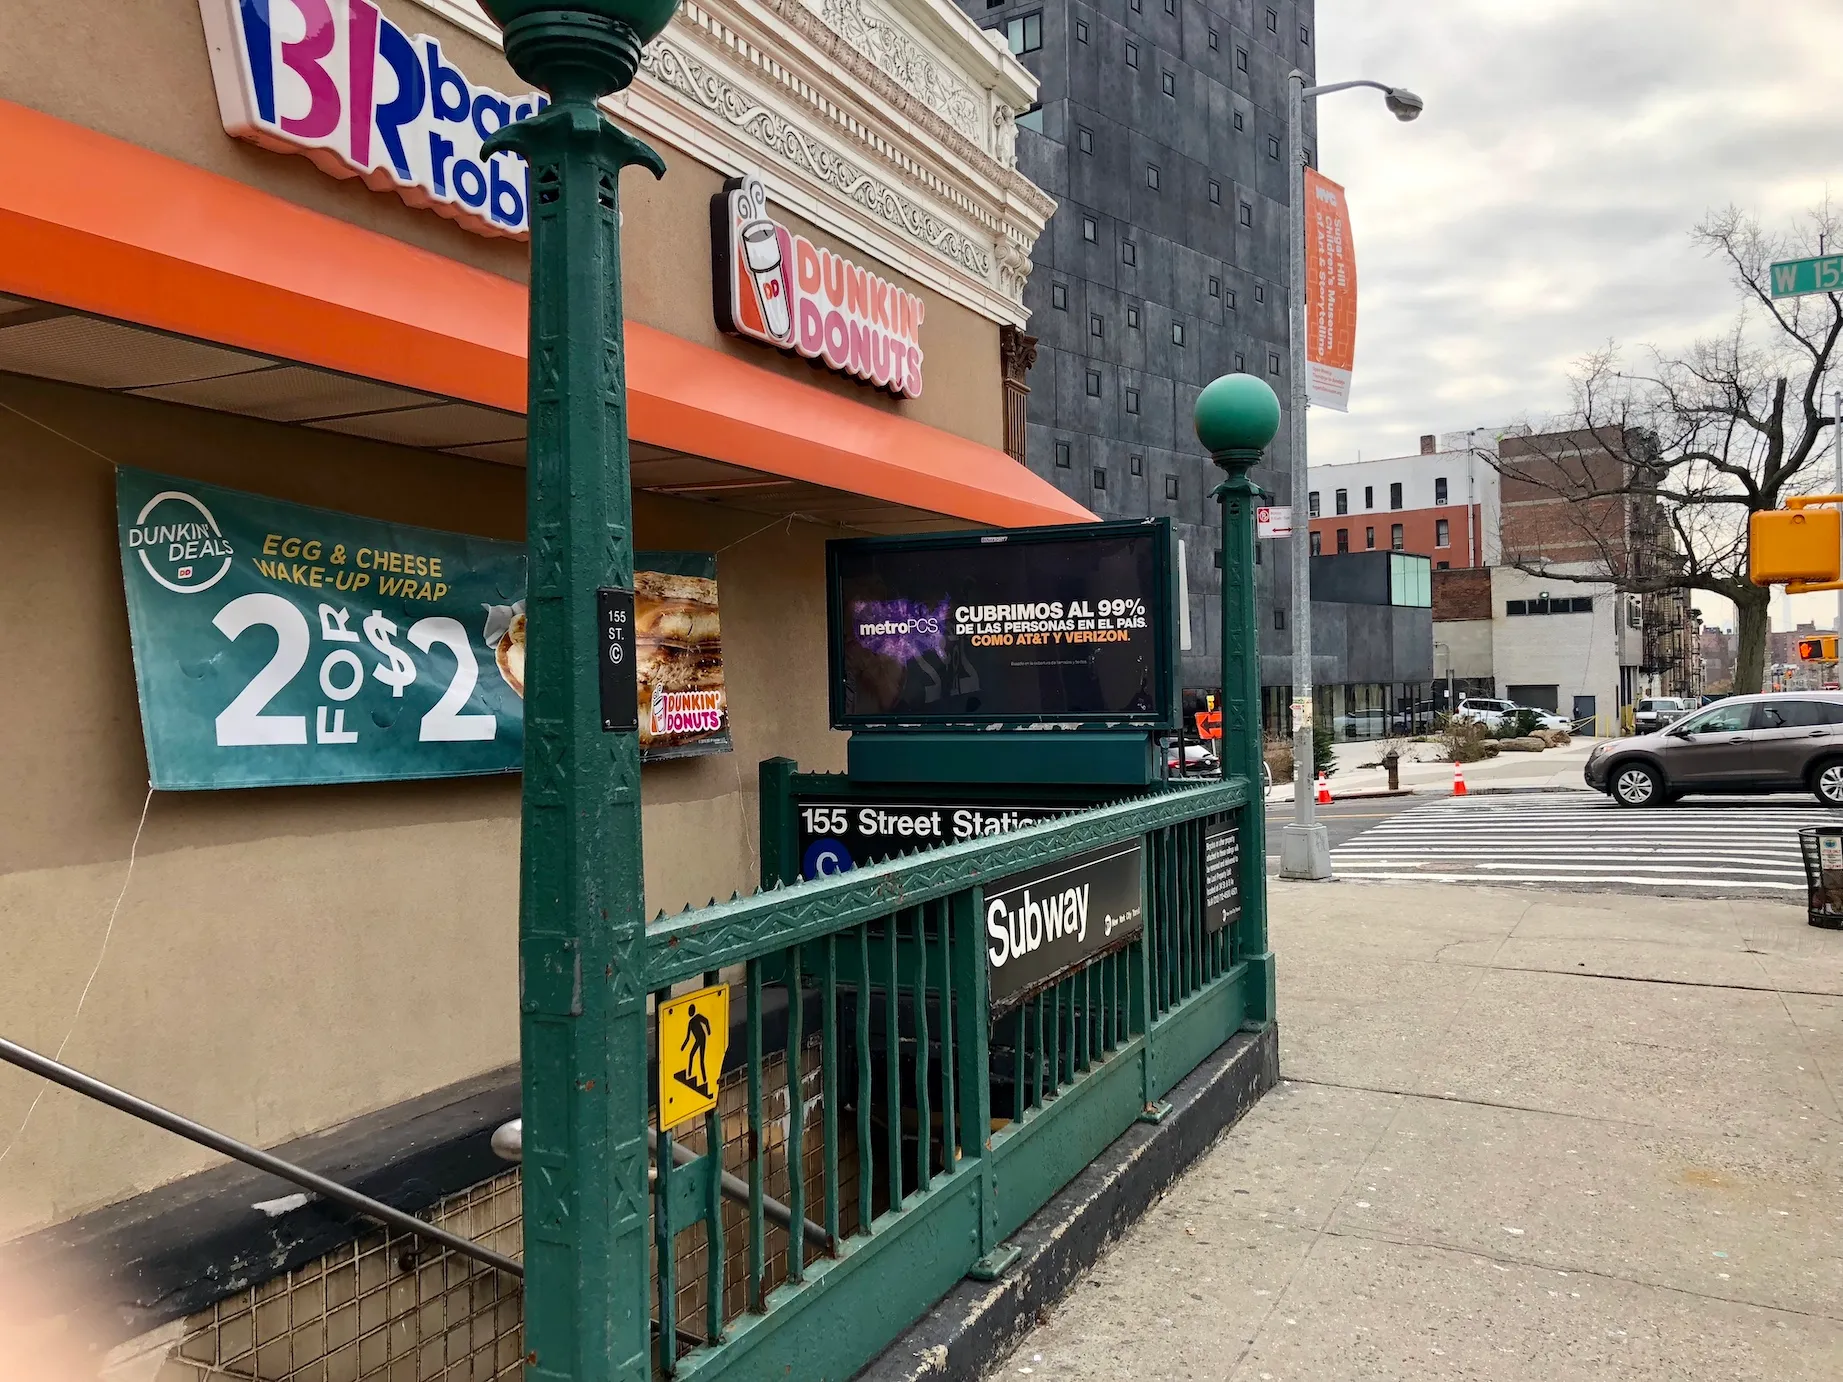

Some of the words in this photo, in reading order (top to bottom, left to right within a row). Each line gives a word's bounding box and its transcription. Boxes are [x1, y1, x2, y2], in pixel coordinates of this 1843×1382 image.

[1316, 212, 1325, 228] of
[1317, 229, 1326, 255] Art
[1325, 215, 1336, 286] Children's
[1333, 217, 1343, 260] Sugar
[1337, 262, 1346, 287] Hill
[1775, 264, 1797, 293] W
[1813, 258, 1843, 289] 15
[764, 279, 779, 301] DD
[797, 238, 925, 345] DUNKIN'
[1326, 289, 1336, 350] Museum
[800, 297, 923, 396] DONUTS
[129, 523, 211, 548] DUNKIN'
[168, 539, 234, 562] DEALS
[262, 534, 322, 561] EGG
[330, 544, 347, 566] &
[356, 548, 443, 578] CHEESE
[252, 557, 371, 592] WAKE-UP
[608, 610, 627, 623] 155
[955, 601, 1064, 623] CUBRIMOS
[1067, 600, 1095, 619] AL
[1097, 597, 1146, 617] 99%
[608, 627, 625, 640] ST.
[859, 618, 939, 636] metroPCS
[956, 623, 974, 635] DE
[977, 622, 1002, 634] LAS
[1004, 619, 1075, 633] PERSONAS
[1077, 618, 1095, 630] EN
[1097, 618, 1114, 629] EL
[1116, 615, 1148, 629] PAÍS.
[971, 633, 1014, 647] COMO
[1016, 631, 1050, 645] AT&T
[1053, 631, 1064, 644] Y
[1064, 629, 1131, 643] VERIZON.
[212, 592, 311, 747] 2
[316, 602, 365, 745] FOR
[668, 693, 720, 713] DUNKIN'
[667, 710, 719, 731] DONUTS
[801, 808, 849, 835] 155
[858, 808, 942, 836] Street
[816, 851, 839, 876] C
[987, 882, 1090, 969] Subway
